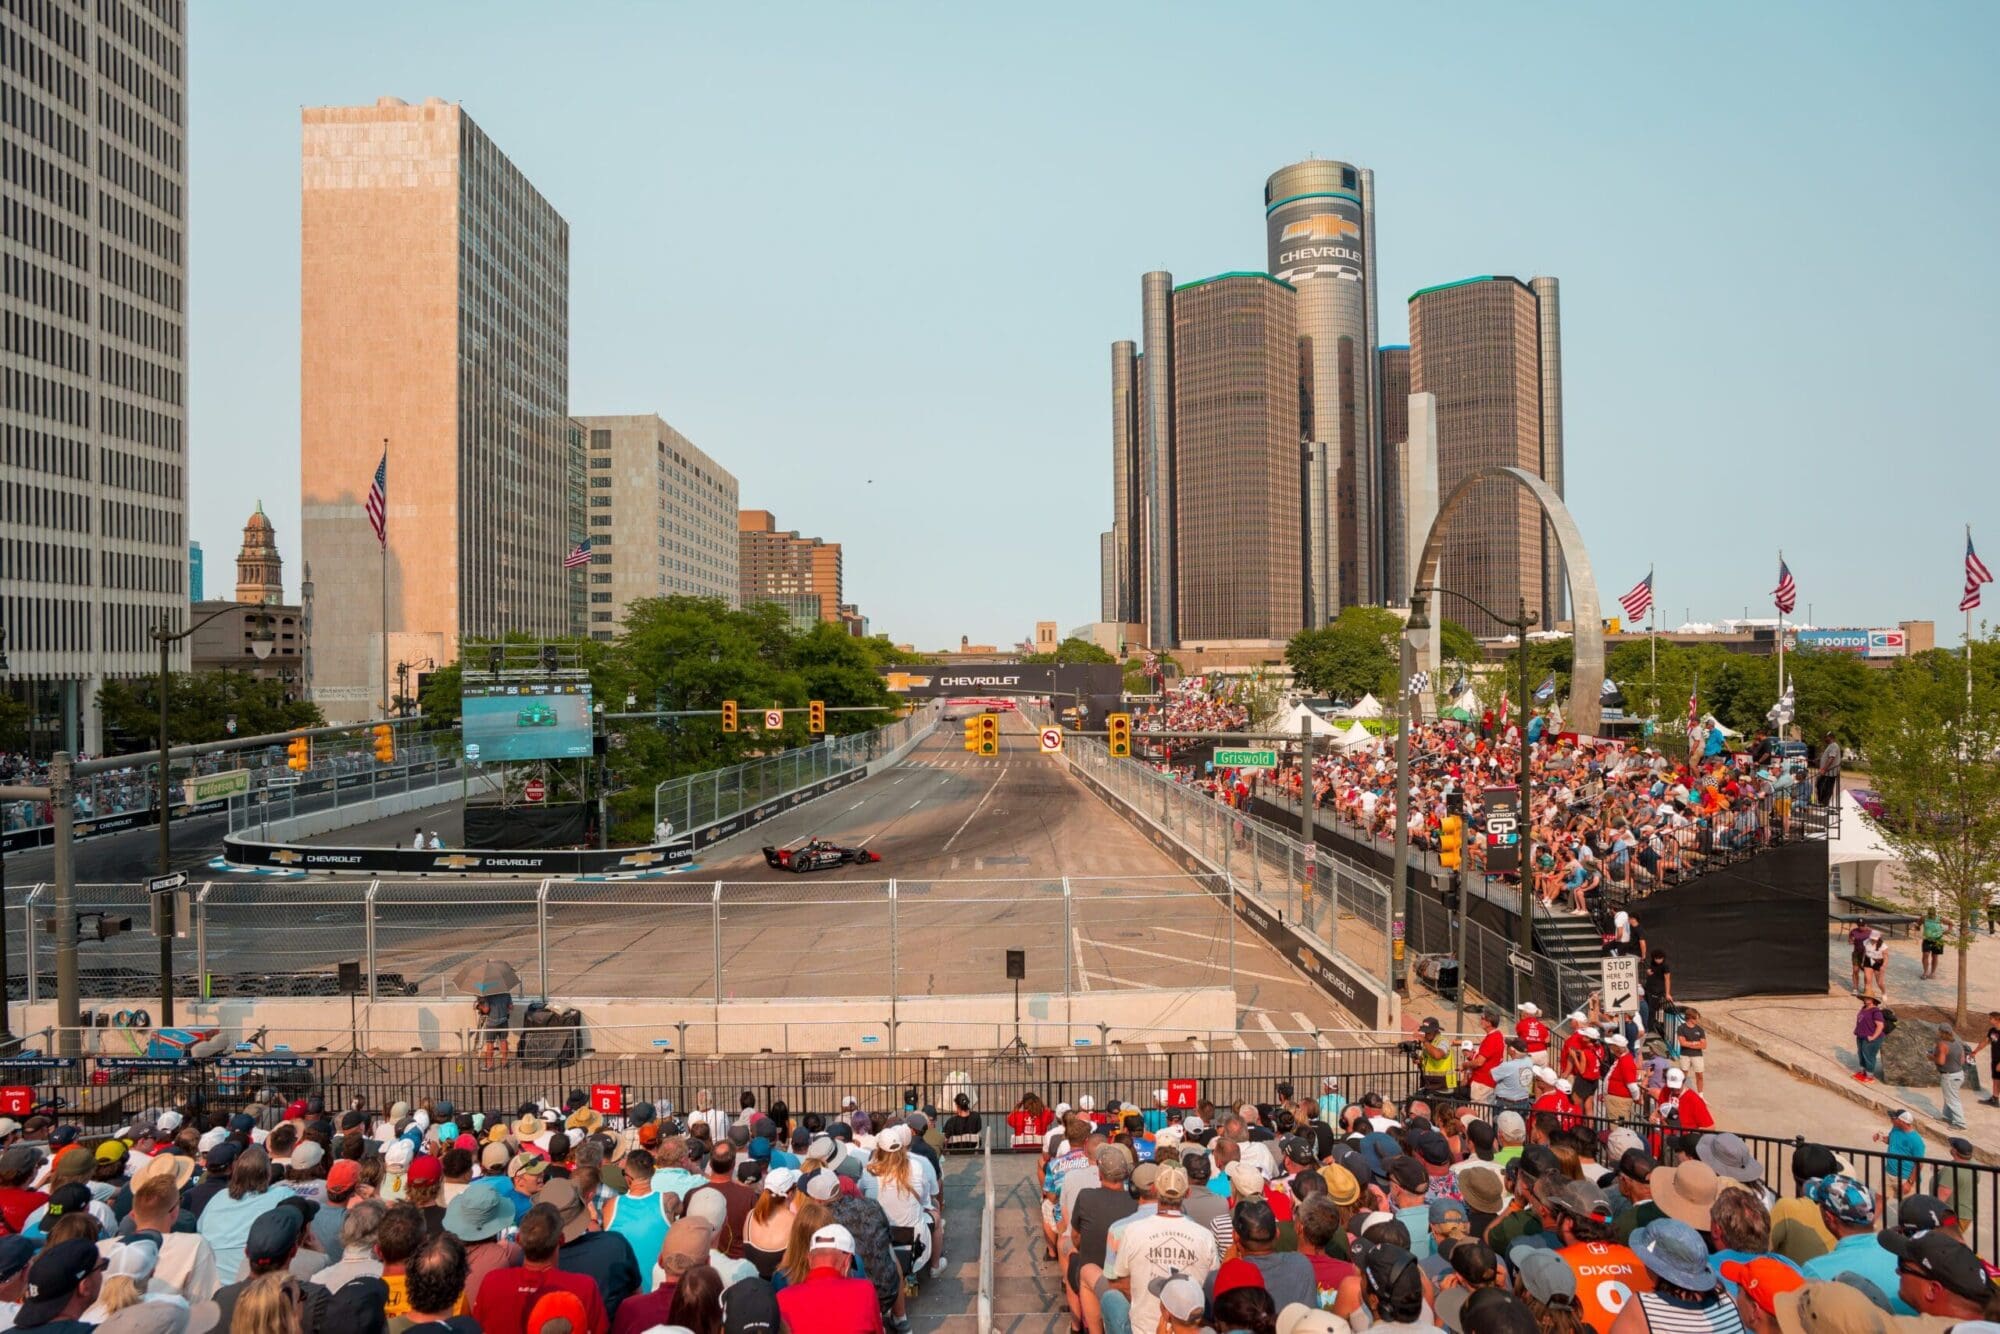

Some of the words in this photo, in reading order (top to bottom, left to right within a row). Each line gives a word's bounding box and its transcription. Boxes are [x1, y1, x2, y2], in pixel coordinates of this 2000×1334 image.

[1818, 638, 1866, 646] ROOFTOP
[940, 676, 1020, 686] CHEVROLET
[1222, 752, 1270, 764] Griswold
[199, 780, 234, 796] Jefferson
[99, 818, 134, 830] CHEVROLET
[1487, 818, 1517, 834] GP
[306, 855, 362, 863] CHEVROLET
[486, 858, 542, 866] CHEVROLET
[1247, 908, 1268, 930] CHEVROLET
[1608, 961, 1632, 970] STOP
[1322, 968, 1356, 1000] CHEVROLET
[1612, 981, 1630, 990] RED
[602, 1098, 610, 1109] B
[1178, 1092, 1186, 1104] A
[12, 1100, 20, 1111] C
[1060, 1158, 1090, 1168] MICHIGA
[1150, 1248, 1195, 1260] INDIAN
[1579, 1264, 1632, 1276] DIXON
